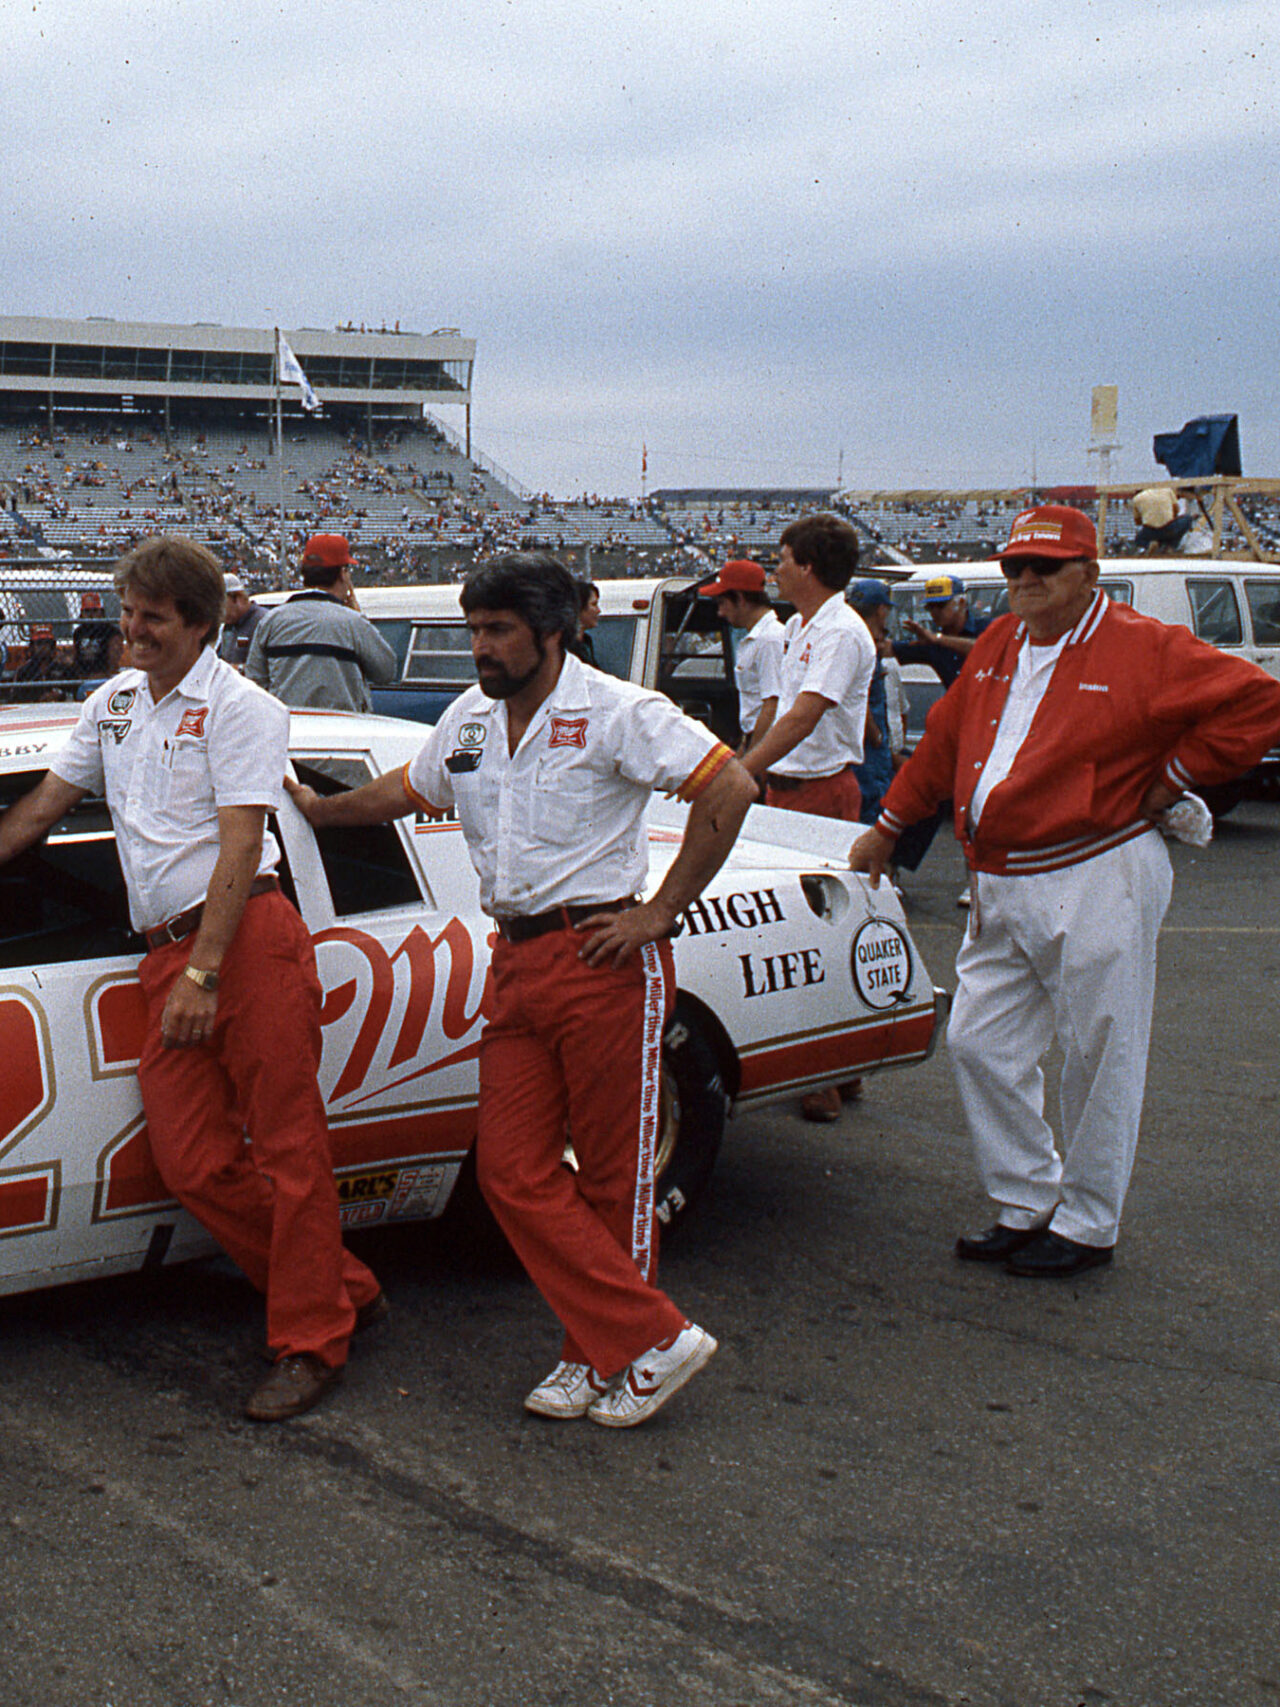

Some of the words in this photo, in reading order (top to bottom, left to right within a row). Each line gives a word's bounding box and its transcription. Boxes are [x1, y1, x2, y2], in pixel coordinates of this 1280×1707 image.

[683, 888, 787, 937] HIGH
[858, 937, 903, 964] QUAKER
[737, 948, 825, 998] LIFE
[867, 964, 901, 990] STATE
[649, 977, 663, 1015] Miller
[646, 1016, 661, 1044] time
